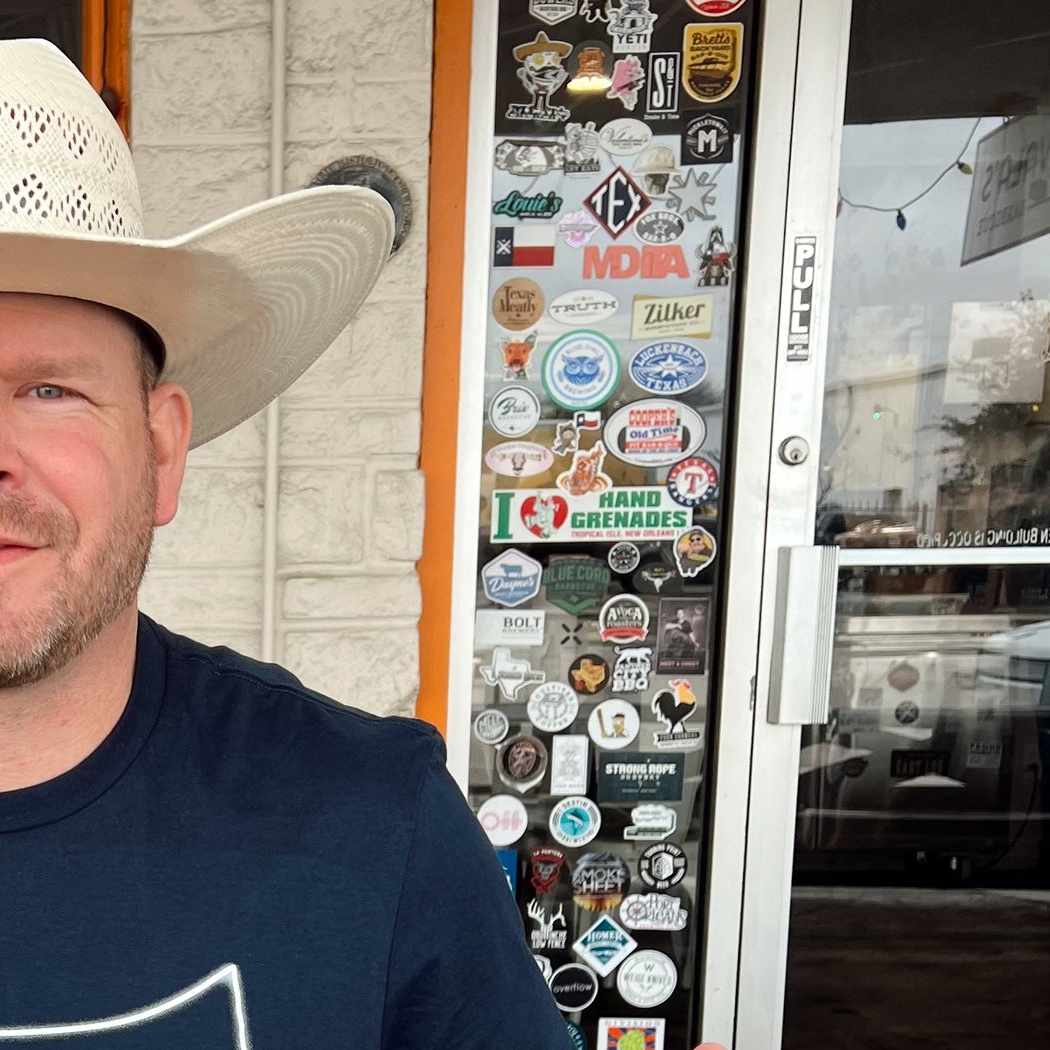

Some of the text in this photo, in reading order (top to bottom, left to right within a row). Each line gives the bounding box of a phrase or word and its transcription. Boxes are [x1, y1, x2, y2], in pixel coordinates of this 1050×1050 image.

[617, 34, 648, 44] YETI
[692, 33, 731, 45] Brett's
[697, 129, 718, 153] M
[495, 191, 562, 215] Louie's
[790, 243, 815, 334] PULL
[550, 300, 617, 313] TRUTH
[644, 301, 706, 325] Zilker
[634, 343, 704, 367] LUCKENBACH
[645, 376, 688, 391] TEXAS
[630, 426, 679, 439] Old Time
[684, 472, 704, 494] T
[598, 490, 662, 508] HAND
[493, 492, 516, 540] I
[570, 511, 688, 529] GRENADES
[643, 529, 675, 537] ORLEANS
[502, 616, 542, 628] BOLT
[611, 680, 649, 692] BBQ
[605, 763, 677, 775] STRONG ROPE
[553, 982, 593, 994] overflow
